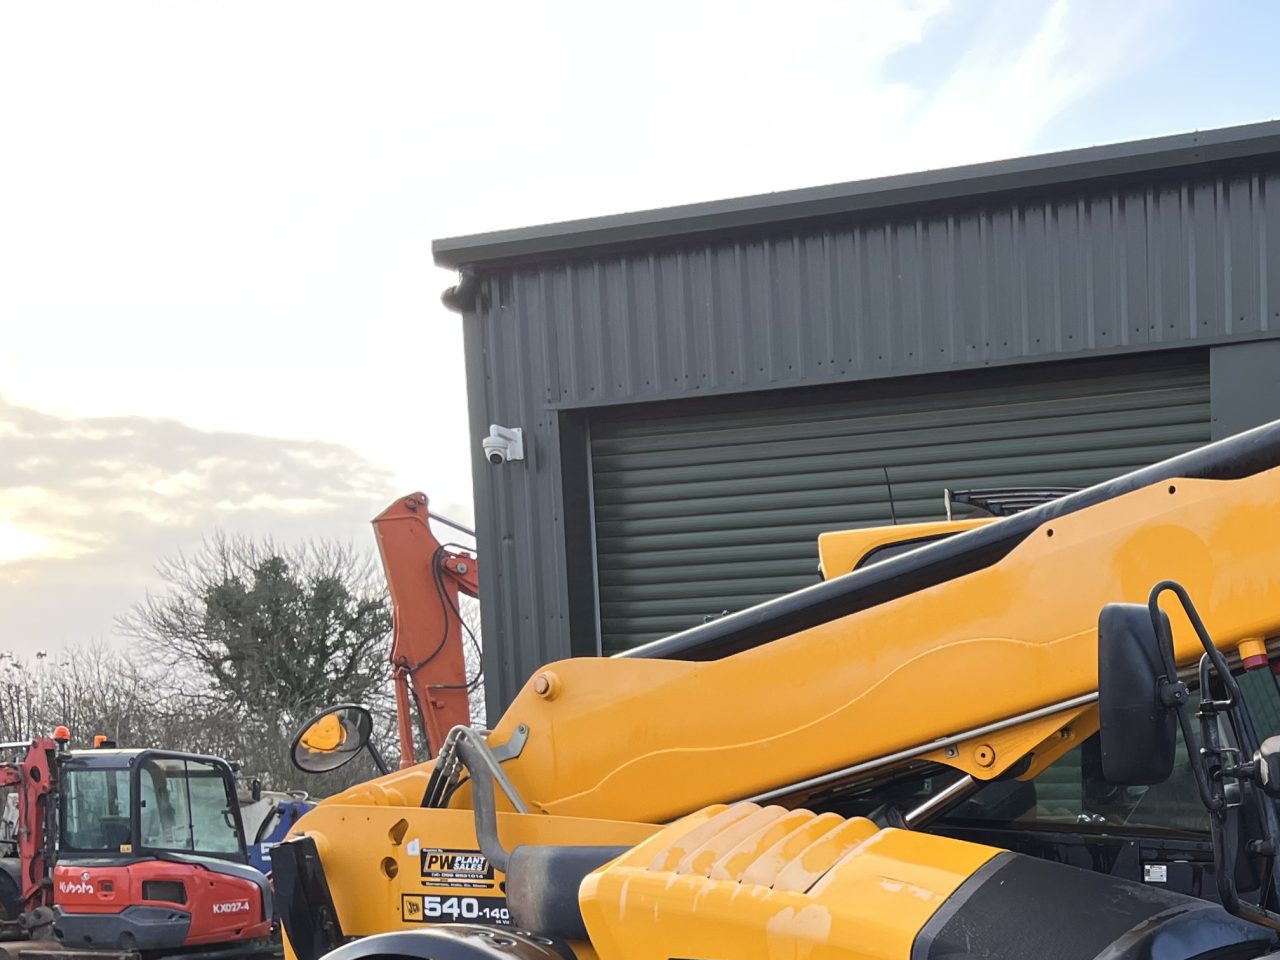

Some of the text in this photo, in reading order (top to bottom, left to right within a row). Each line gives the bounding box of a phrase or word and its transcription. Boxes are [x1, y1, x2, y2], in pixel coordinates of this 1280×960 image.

[427, 855, 456, 870] PW
[455, 856, 486, 864] PLANT
[453, 863, 483, 871] SALES
[59, 881, 94, 894] Kubota
